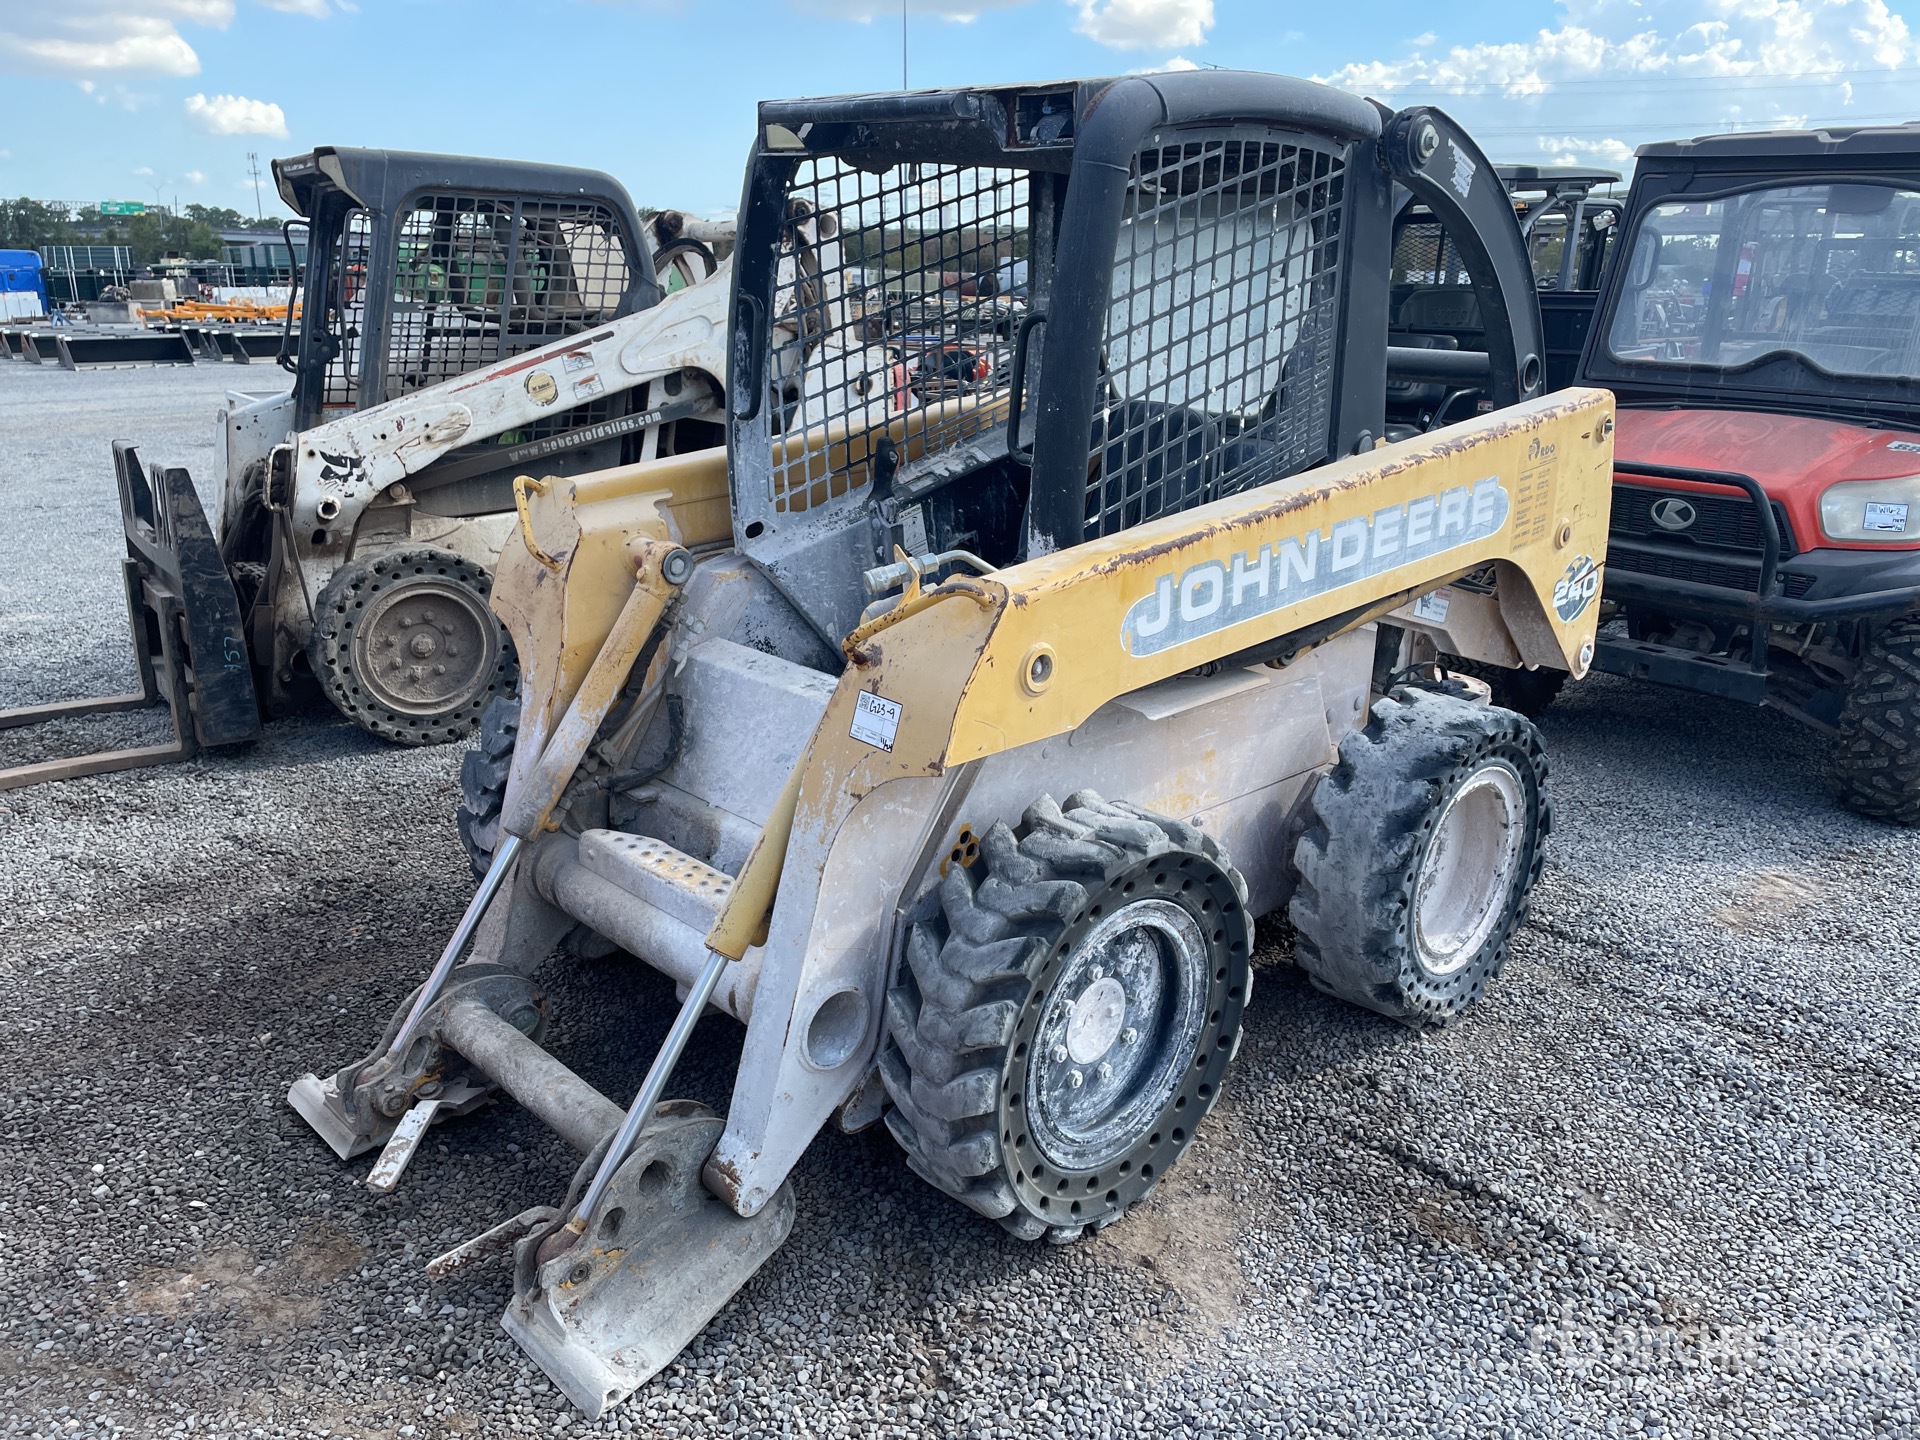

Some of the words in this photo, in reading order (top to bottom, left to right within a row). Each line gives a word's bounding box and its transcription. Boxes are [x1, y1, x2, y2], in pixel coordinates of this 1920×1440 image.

[1541, 443, 1556, 457] RDO
[1136, 533, 1319, 637] JOHN
[1332, 478, 1497, 573] DEERE
[1552, 562, 1598, 608] 240
[869, 699, 895, 719] G23-9
